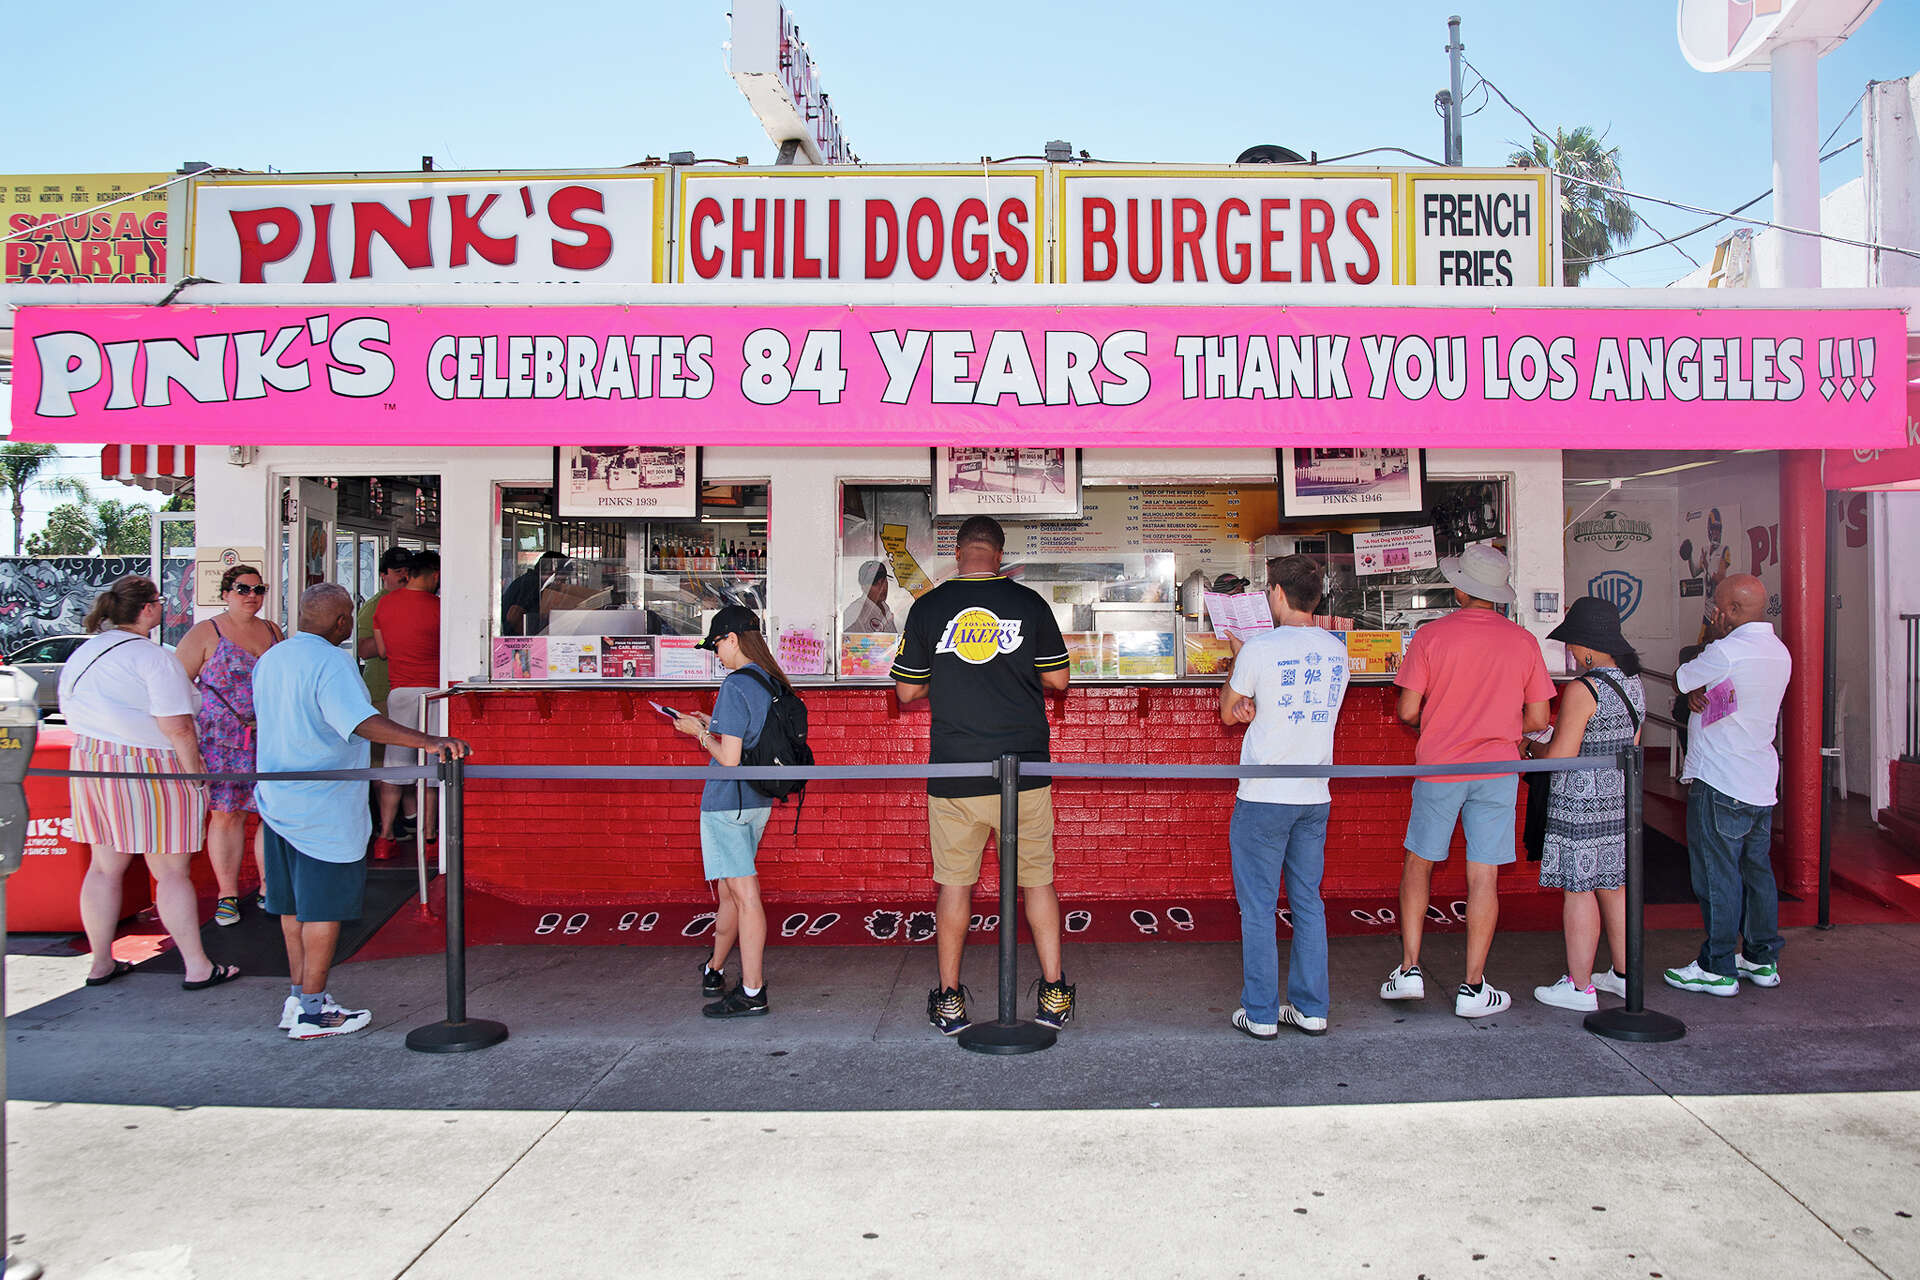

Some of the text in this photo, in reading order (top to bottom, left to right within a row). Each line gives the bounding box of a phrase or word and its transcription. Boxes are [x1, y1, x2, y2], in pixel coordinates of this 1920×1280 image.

[1423, 193, 1532, 237] FRENCH
[228, 185, 615, 284] PINK'S
[689, 196, 1031, 282] CHILI DOGS
[1081, 196, 1381, 285] BURGERS
[1439, 249, 1514, 286] FRIES
[32, 314, 396, 418] PINK'S
[426, 335, 715, 401] CELEBRATES
[740, 328, 848, 405] 84
[870, 329, 1152, 407] YEARS
[1175, 334, 1353, 401] THANK
[1361, 334, 1468, 401] YOU
[1483, 335, 1578, 401] LOS
[1590, 336, 1805, 402] ANGELES
[598, 497, 658, 507] PINK'S 1939
[977, 494, 1012, 504] PINK'S
[1322, 493, 1383, 505] PINK'S 1946
[1584, 534, 1642, 542] HOLLYWOOD
[944, 623, 1016, 650] LAKERS
